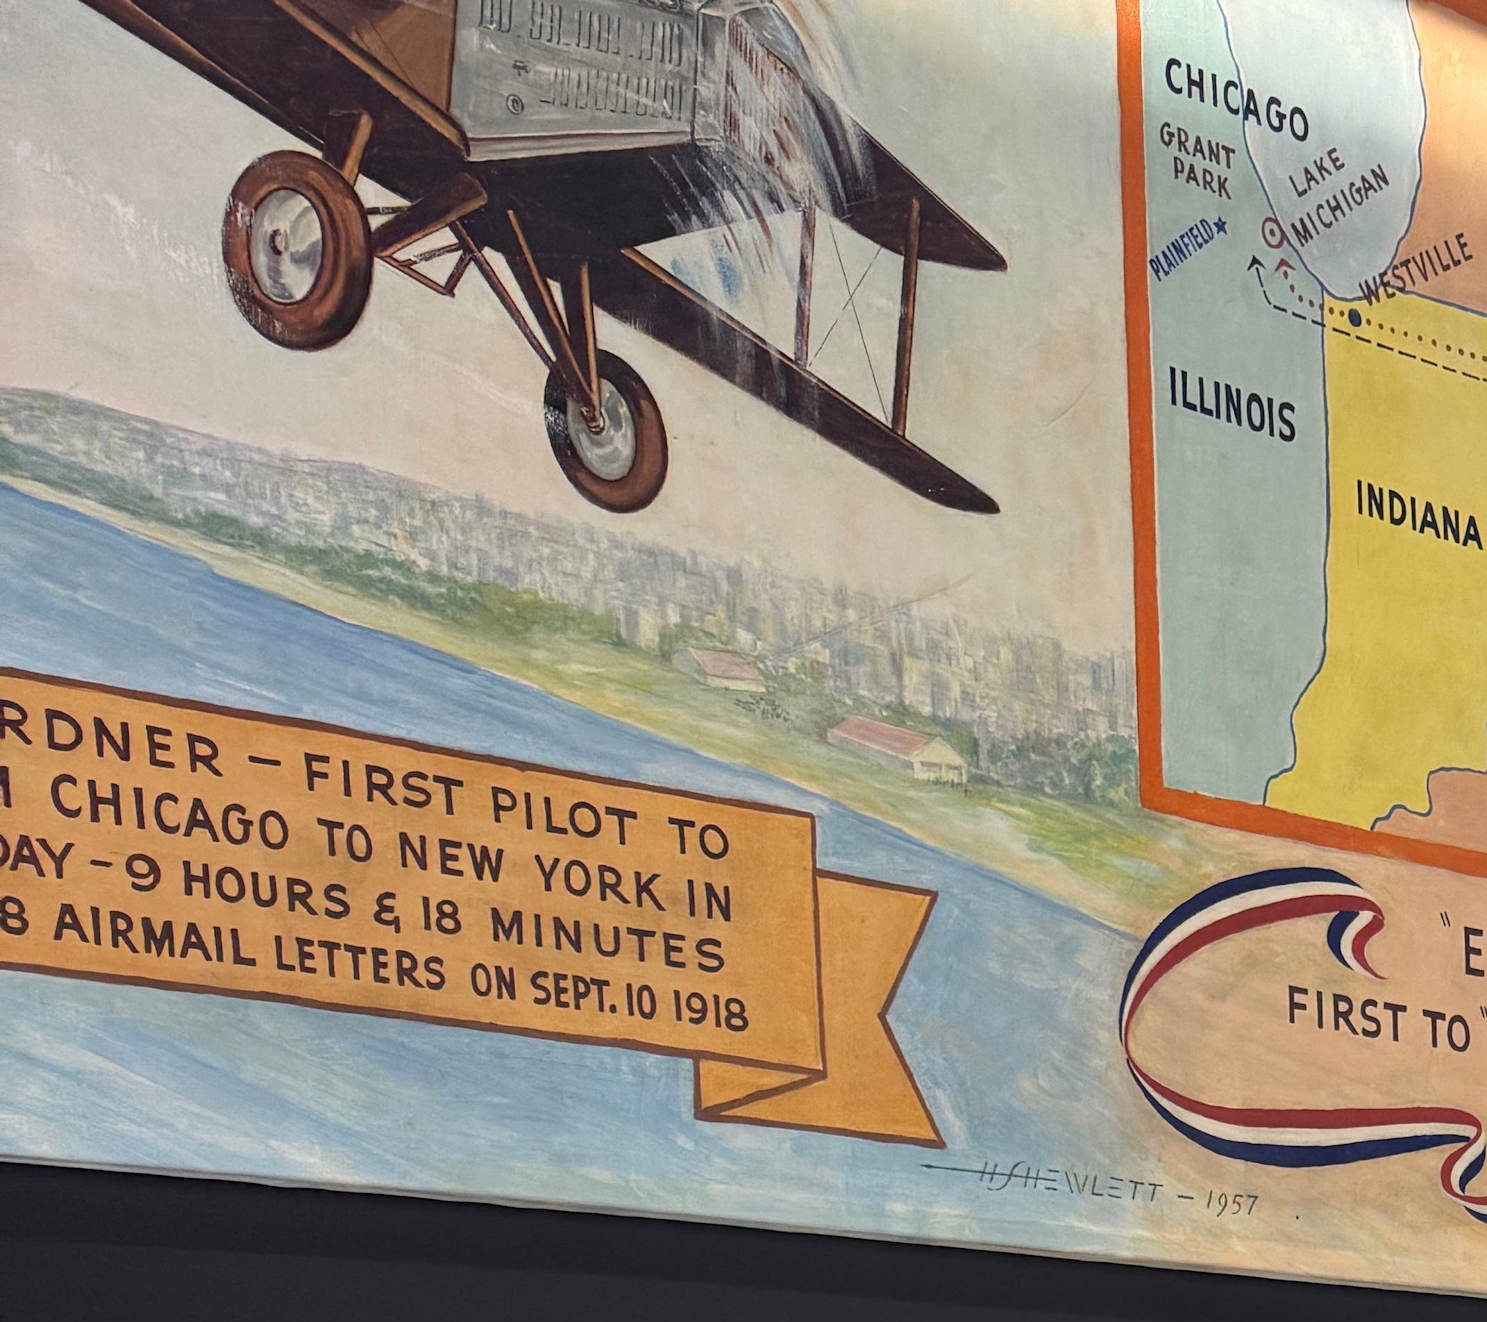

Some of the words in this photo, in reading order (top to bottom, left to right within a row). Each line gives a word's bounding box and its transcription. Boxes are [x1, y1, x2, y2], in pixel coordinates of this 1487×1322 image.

[1164, 58, 1309, 141] CHICAGO
[1159, 122, 1236, 170] GRANT
[1173, 156, 1231, 200] PARK
[1288, 147, 1346, 198] LAKE
[1290, 164, 1390, 247] MICHIGAN
[1149, 218, 1214, 282] PLAINFIELD
[1358, 233, 1474, 307] WESTVILLE
[1169, 365, 1296, 443] ILLINOIS
[1356, 479, 1483, 551] INDIANA
[304, 752, 464, 815] FIRST
[491, 786, 638, 846] PILOT
[668, 816, 729, 860] TO
[50, 773, 289, 851] CHICAGO
[317, 817, 374, 863] TO
[399, 832, 504, 883] NEW
[534, 854, 666, 912] YORK
[687, 879, 732, 922] IN
[125, 853, 161, 892] 9
[182, 859, 350, 919] HOURS
[374, 891, 401, 934] &
[422, 896, 462, 935] 18
[491, 907, 725, 973] MINUTES
[53, 903, 257, 967] AIRMAIL
[274, 935, 446, 991] LETTERS
[470, 963, 517, 1001] ON
[530, 970, 617, 1015] SEPT.
[626, 982, 657, 1021] 10
[673, 989, 750, 1033] 1918
[1287, 985, 1408, 1044] FIRST
[1421, 1010, 1471, 1053] TO
[1206, 1190, 1258, 1218] 1957
